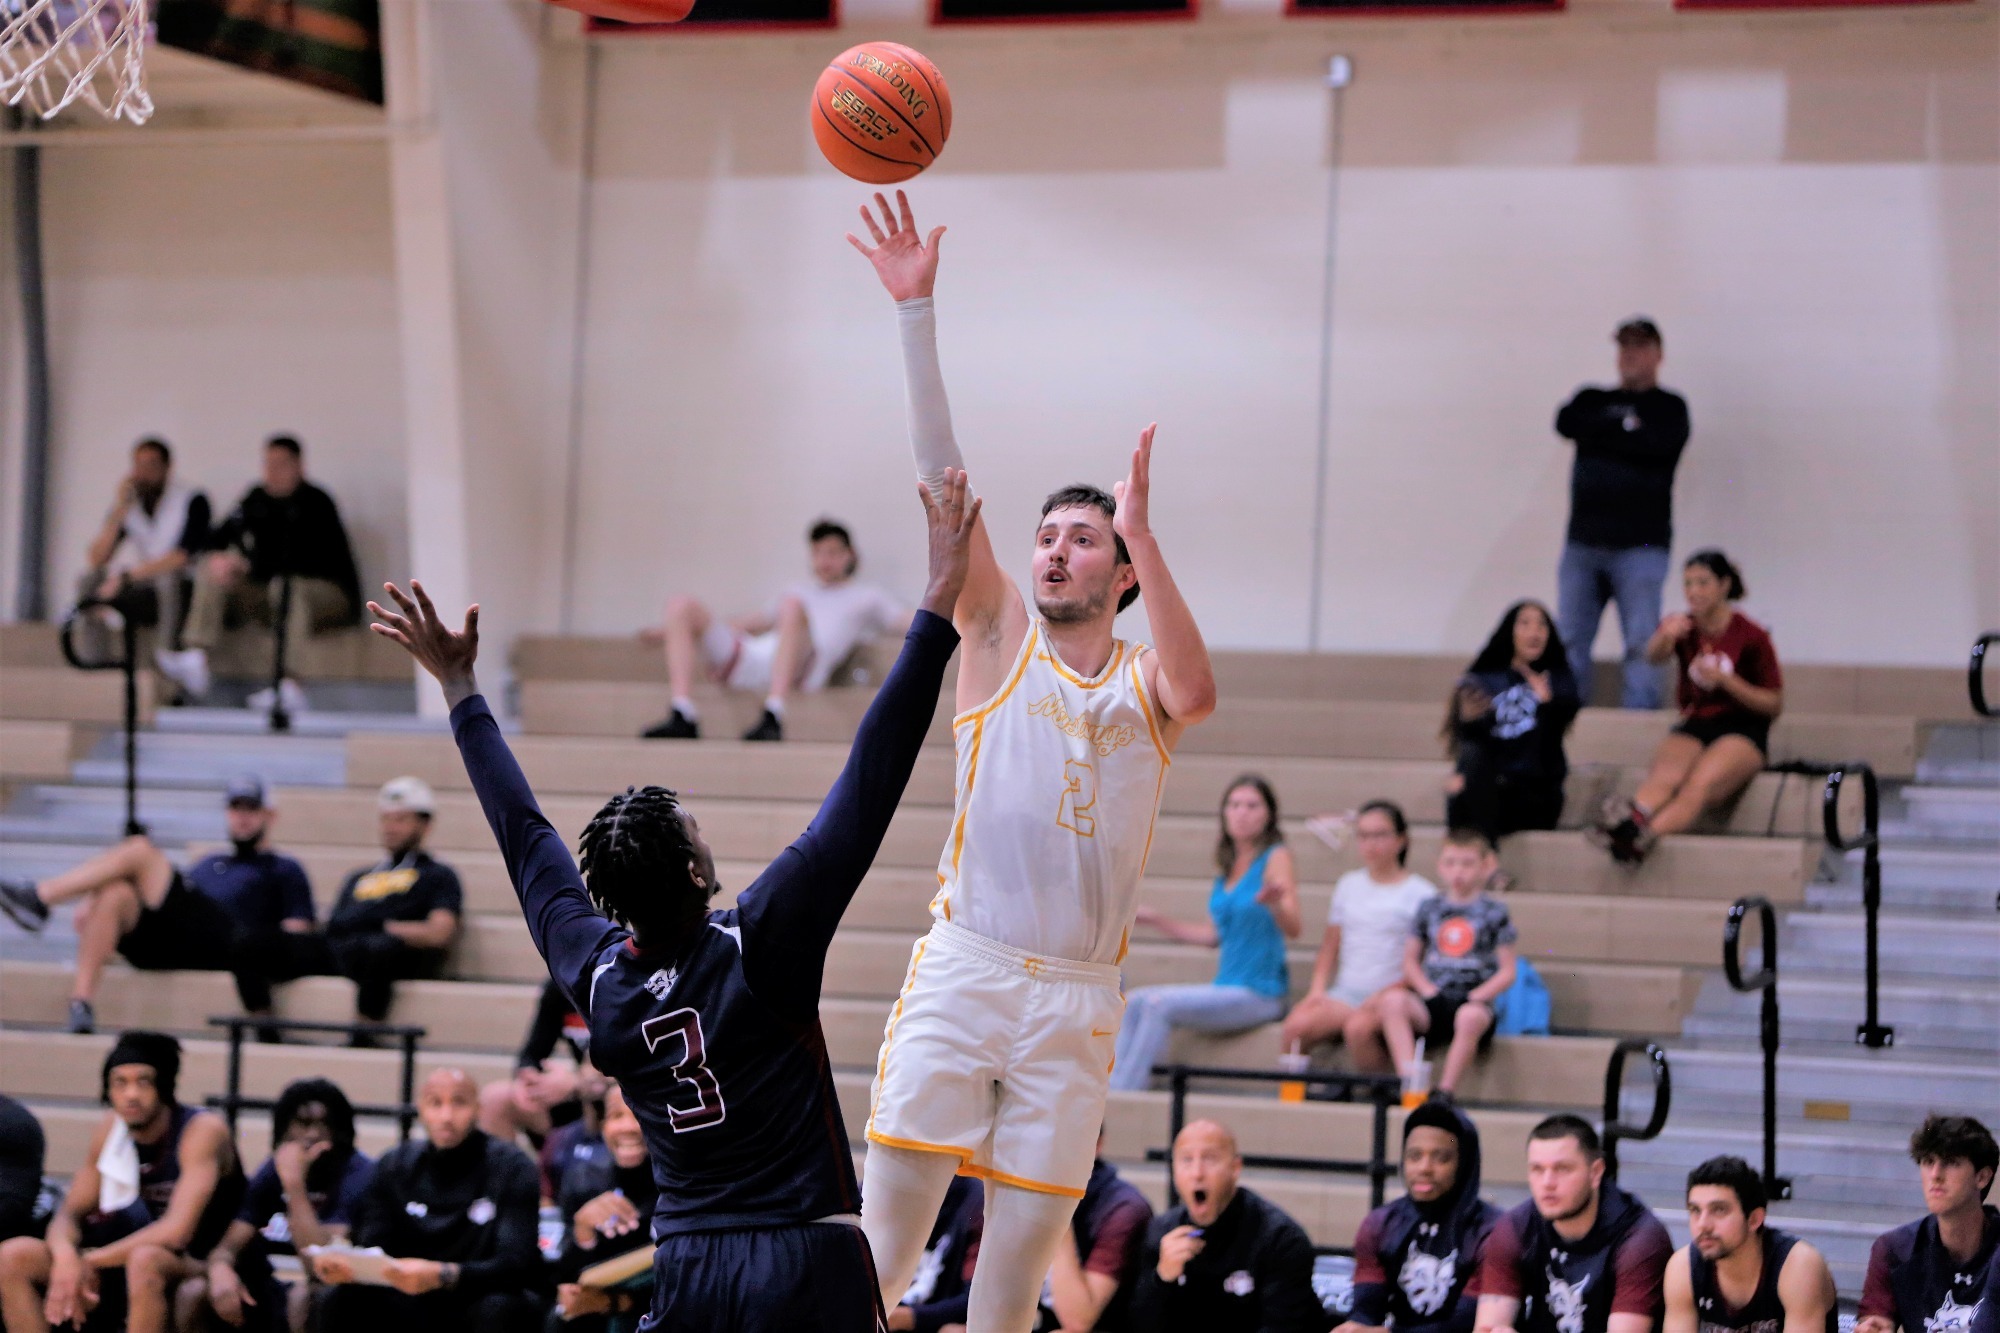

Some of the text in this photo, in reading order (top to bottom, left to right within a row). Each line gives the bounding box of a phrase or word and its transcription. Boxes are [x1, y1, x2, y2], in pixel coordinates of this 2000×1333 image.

[833, 81, 900, 136] LEGACY
[851, 52, 930, 120] SPALDING
[842, 108, 884, 141] 1000
[1056, 758, 1096, 838] 2
[641, 1007, 726, 1133] 3
